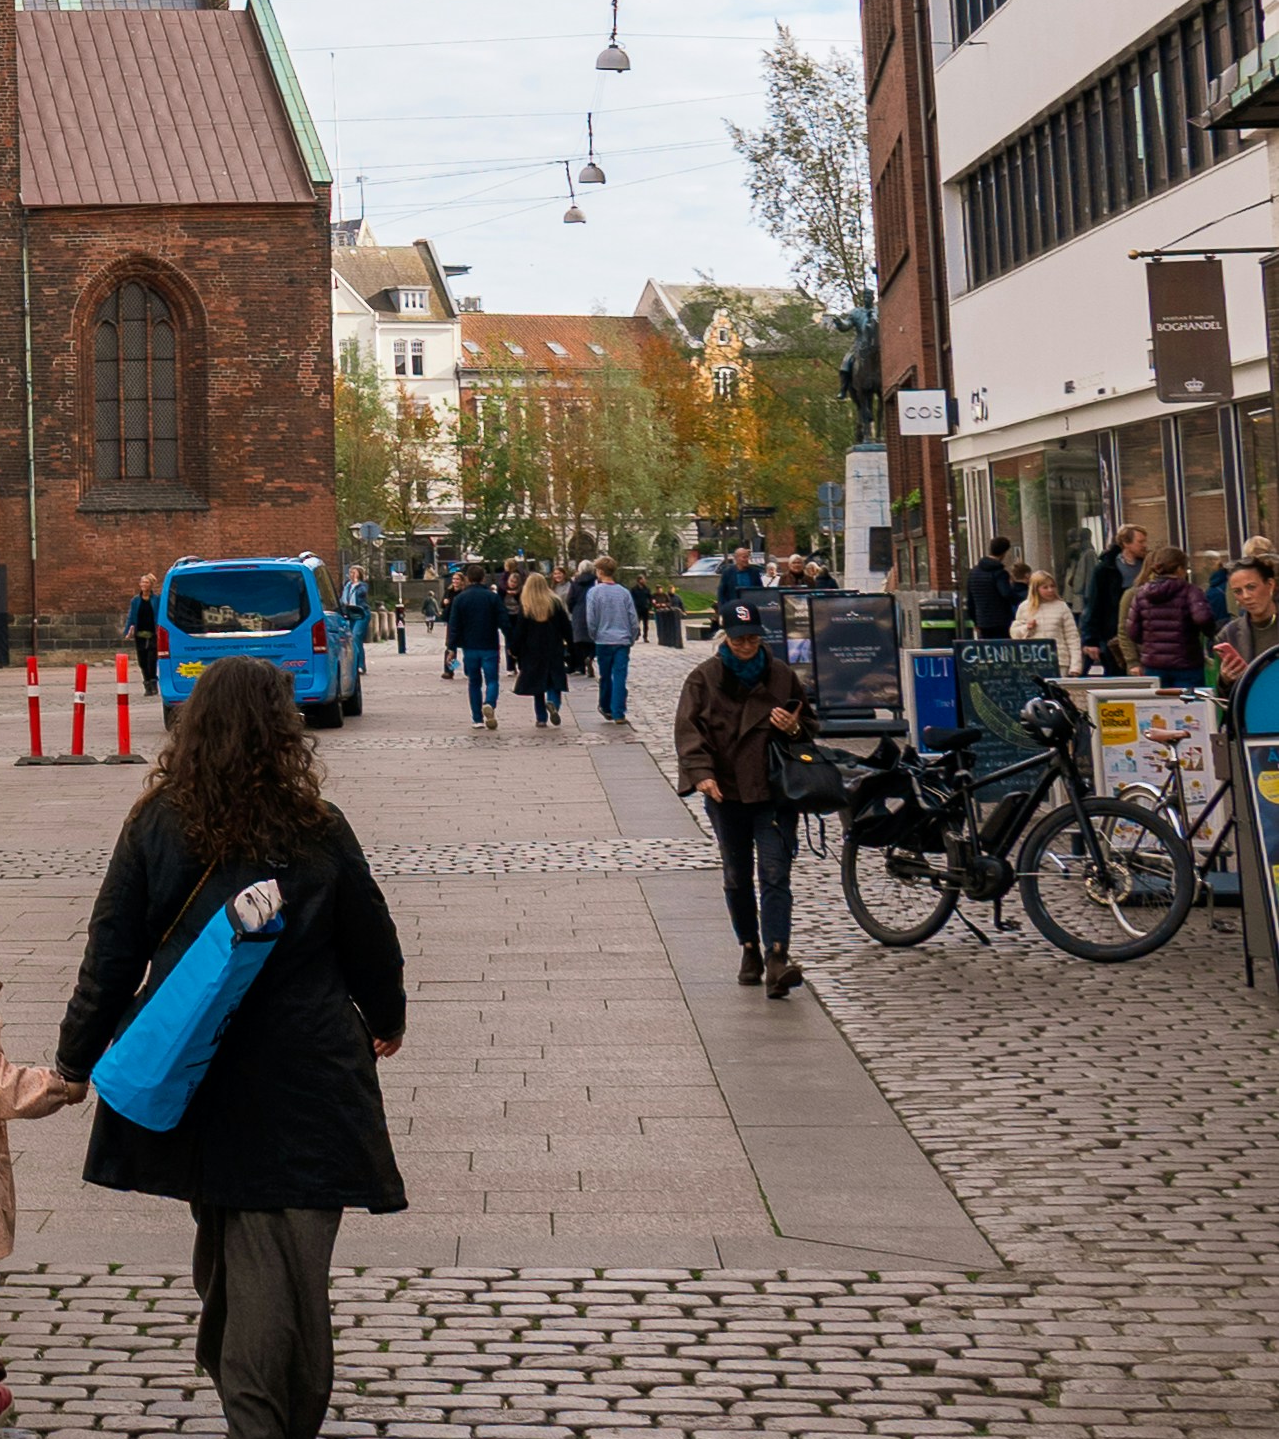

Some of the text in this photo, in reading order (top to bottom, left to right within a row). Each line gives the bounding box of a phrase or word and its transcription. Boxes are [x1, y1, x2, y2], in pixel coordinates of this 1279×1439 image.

[1156, 321, 1223, 332] BOGHANDEL
[904, 406, 943, 420] COS
[961, 644, 1017, 665] GLENN
[1101, 708, 1125, 718] Godt
[1101, 718, 1131, 727] tilbud
